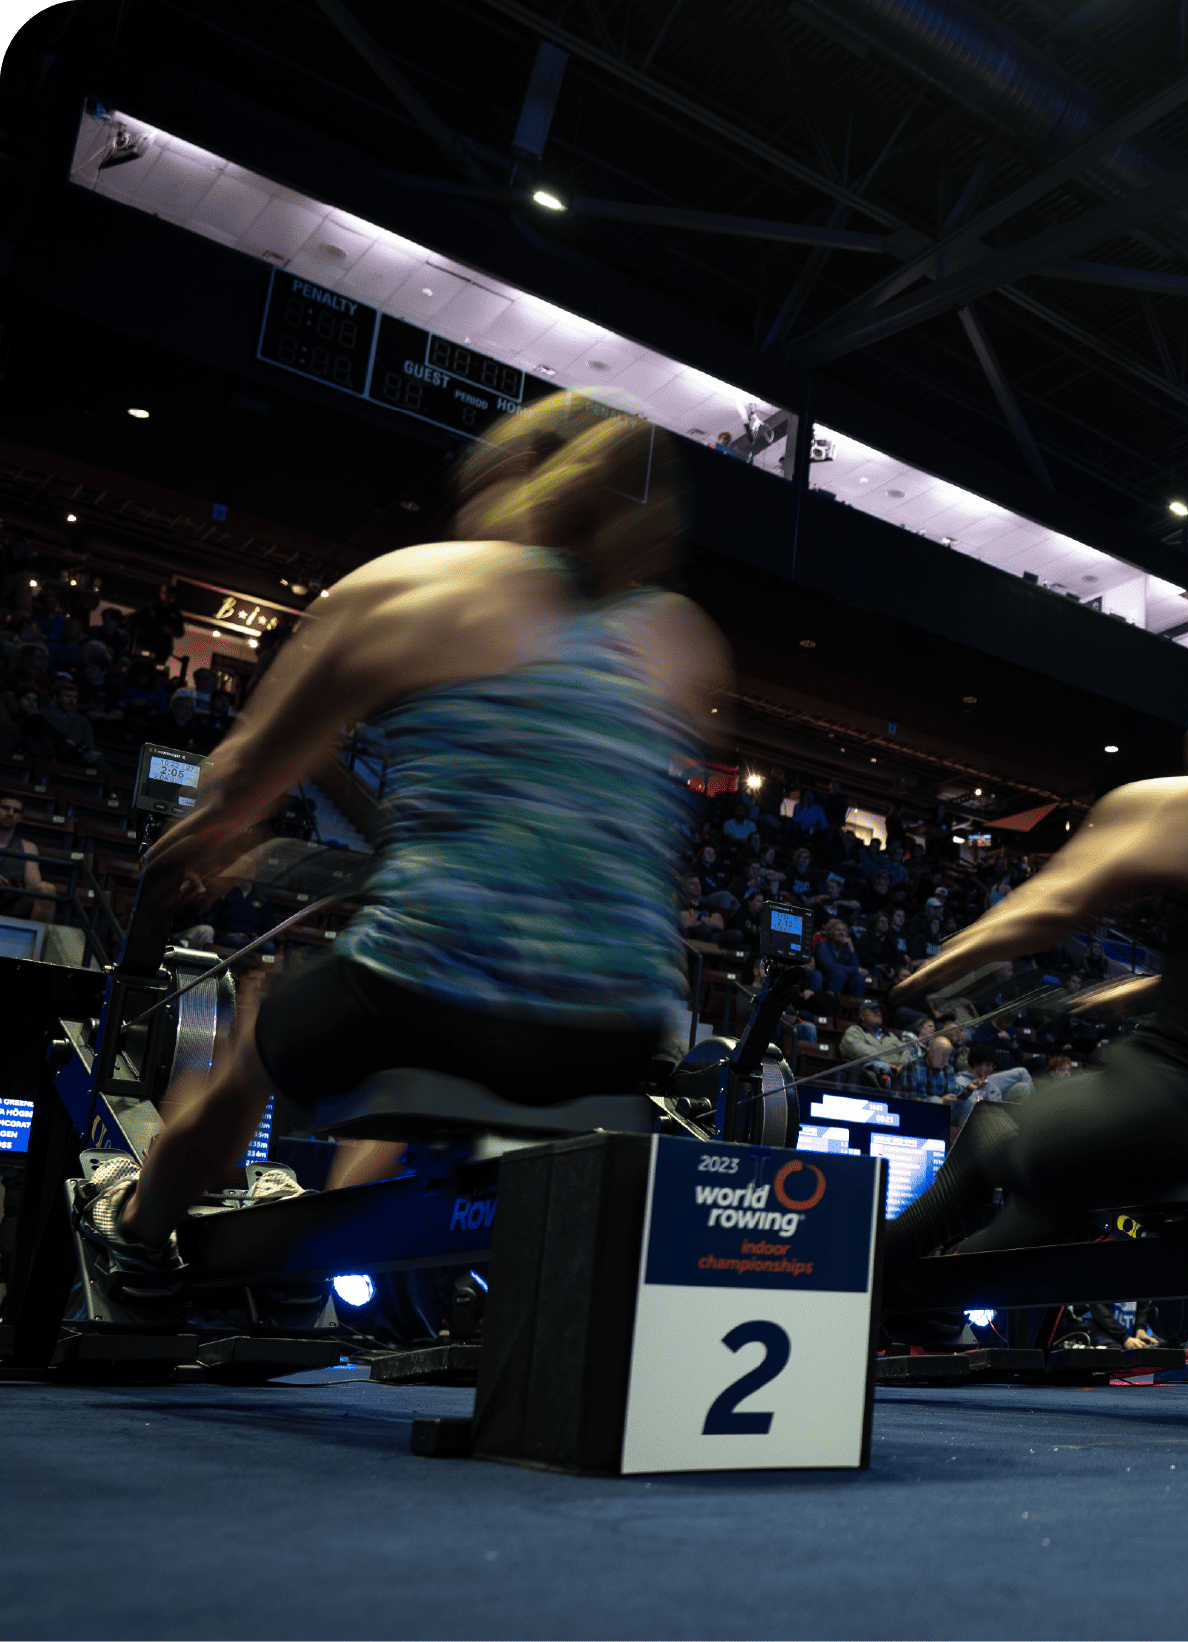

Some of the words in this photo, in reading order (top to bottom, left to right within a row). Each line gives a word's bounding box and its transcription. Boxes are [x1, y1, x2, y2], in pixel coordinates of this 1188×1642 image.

[291, 279, 358, 316] PENALTY
[402, 359, 450, 389] GUEST
[453, 388, 488, 410] PERIOD
[160, 765, 185, 778] 2:05
[697, 1154, 741, 1175] 2023
[694, 1182, 771, 1209] world
[706, 1208, 801, 1239] rowing
[740, 1238, 792, 1256] indoor
[697, 1253, 815, 1278] championships
[701, 1319, 791, 1435] 2
